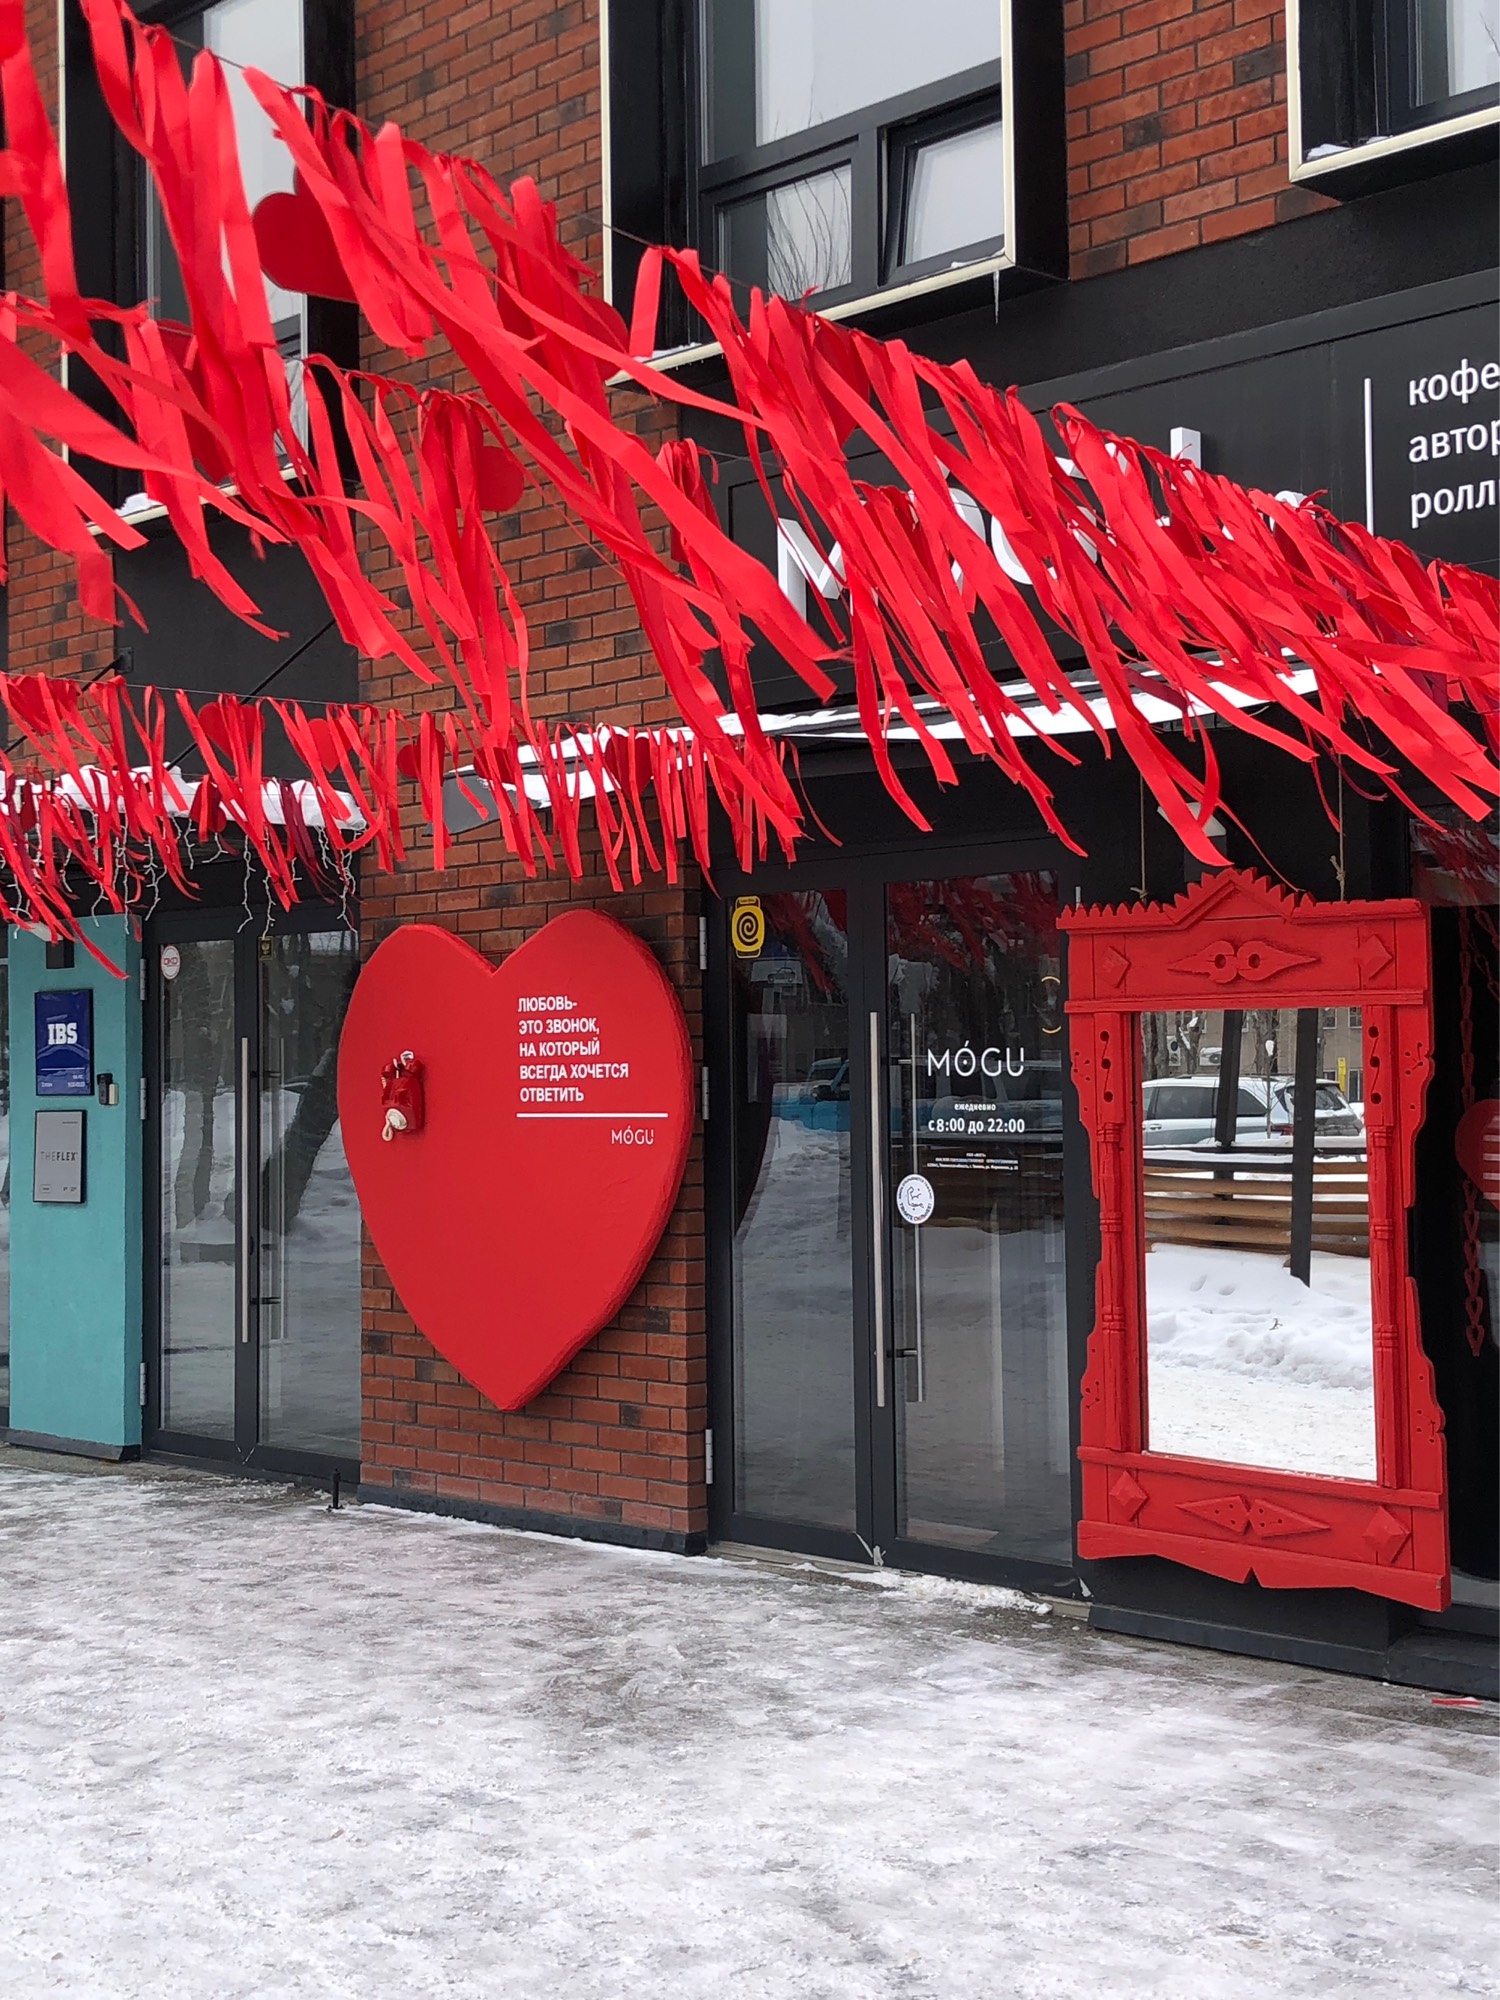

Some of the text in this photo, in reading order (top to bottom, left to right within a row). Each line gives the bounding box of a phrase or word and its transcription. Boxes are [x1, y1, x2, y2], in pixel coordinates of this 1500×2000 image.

[1410, 479, 1500, 529] ролл
[517, 995, 578, 1012] ЛЮБОВЬ-
[47, 1022, 78, 1046] IBS
[518, 1017, 600, 1035] ЭТО ЗВОНОК,
[519, 1037, 600, 1057] НА КОТОРЫЙ
[927, 1039, 1024, 1077] MÓGU
[519, 1062, 629, 1081] ВСЕГДА ХОЧЕТСЯ
[519, 1086, 585, 1102] ОТВЕТИТЬ
[954, 1103, 997, 1112] ежедневно
[967, 1120, 985, 1135] до
[987, 1118, 1026, 1133] 22:00
